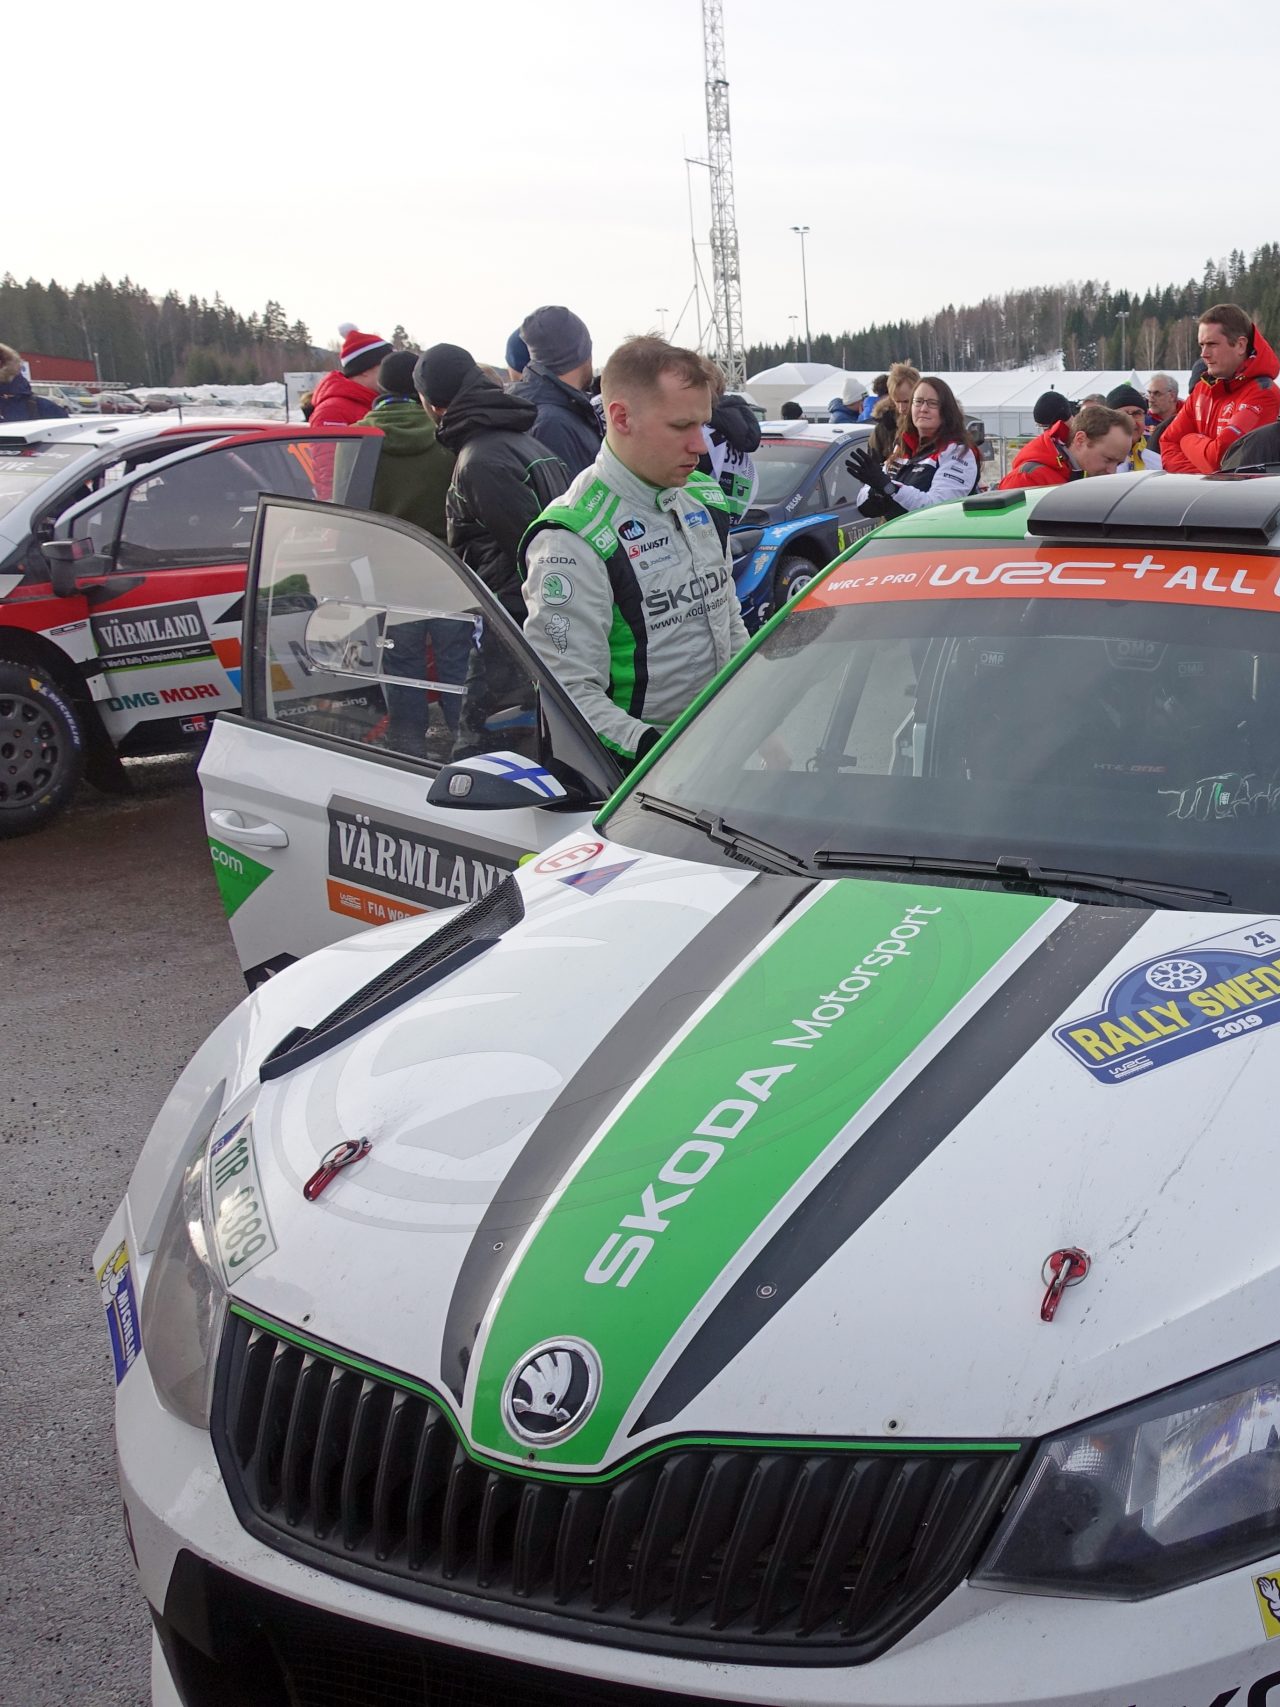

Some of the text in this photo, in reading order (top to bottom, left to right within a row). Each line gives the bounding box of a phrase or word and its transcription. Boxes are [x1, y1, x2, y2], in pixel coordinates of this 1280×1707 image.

[785, 493, 803, 512] PULSAR
[646, 566, 729, 617] ŠKODA
[827, 577, 864, 592] WRC
[865, 575, 878, 586] 2
[881, 572, 917, 585] PRO
[1163, 565, 1257, 595] ALL
[99, 613, 201, 648] VÄRMLAND
[979, 652, 1005, 665] OMP
[110, 683, 221, 712] DMG MORI
[336, 813, 512, 902] VÄRMLAN
[368, 900, 386, 918] FIA
[1243, 930, 1277, 949] 25
[771, 904, 943, 1049] Motorsport
[1068, 1000, 1191, 1062] RALLY
[1212, 1014, 1263, 1040] 2019
[117, 1287, 138, 1364] MICHELIN
